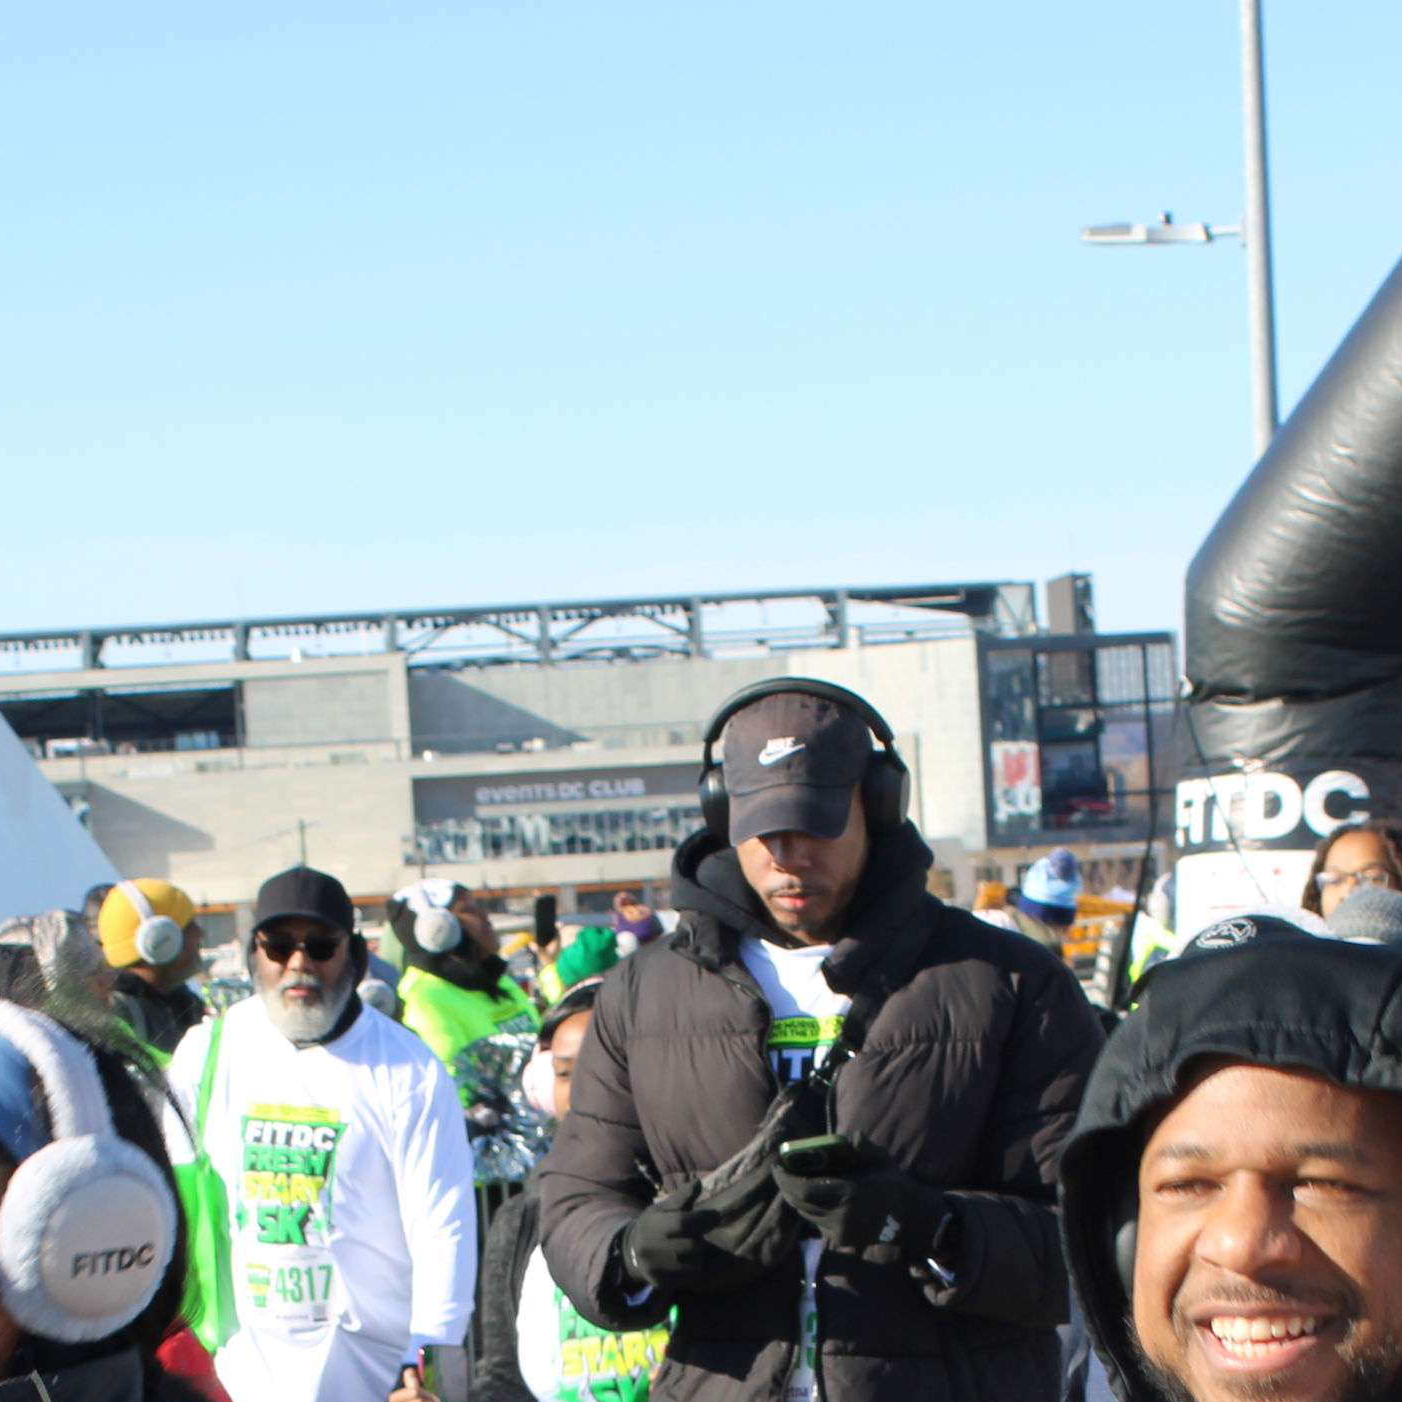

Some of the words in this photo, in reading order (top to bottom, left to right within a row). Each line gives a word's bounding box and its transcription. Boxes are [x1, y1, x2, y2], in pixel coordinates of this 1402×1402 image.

[588, 777, 645, 799] CLUB
[245, 1119, 336, 1151] FITDC
[244, 1144, 328, 1177] FRESH
[244, 1171, 326, 1205] START
[257, 1202, 311, 1245] 5K
[72, 1242, 155, 1279] FITDC
[275, 1264, 333, 1303] 4317
[561, 1328, 670, 1377] START
